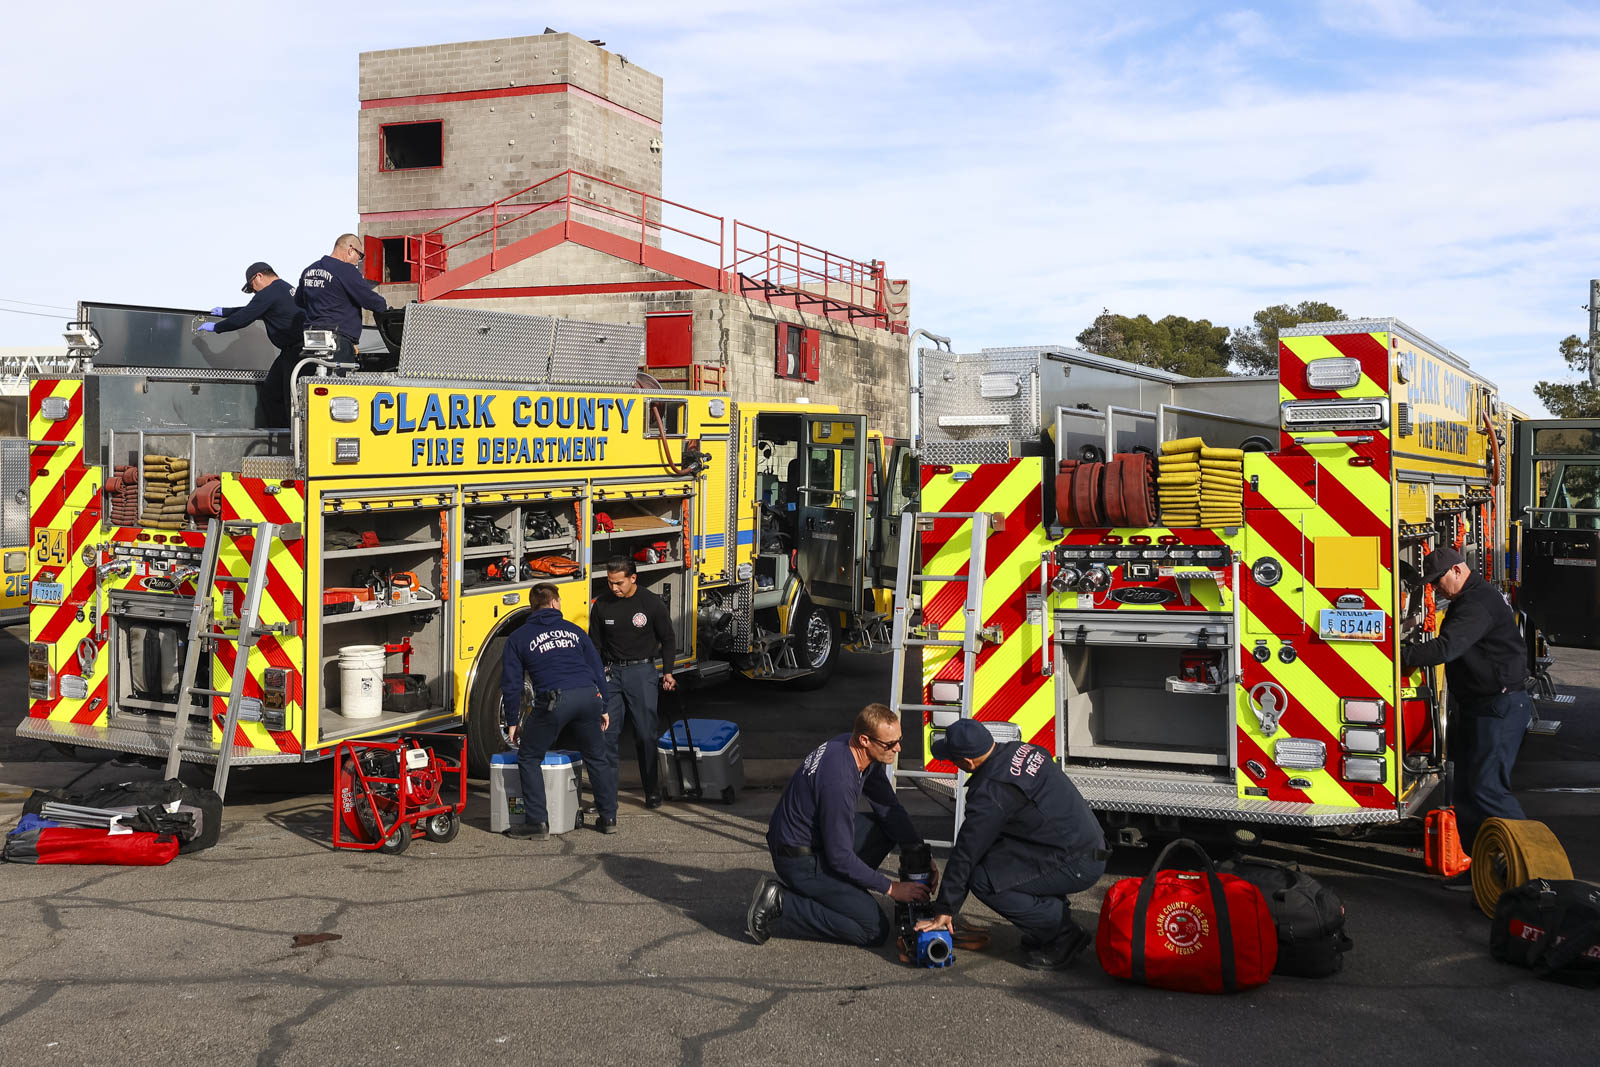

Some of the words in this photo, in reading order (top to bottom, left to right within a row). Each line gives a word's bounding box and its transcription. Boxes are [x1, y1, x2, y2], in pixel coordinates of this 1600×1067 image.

[1408, 350, 1440, 408] CLARK
[370, 392, 496, 436] CLARK
[512, 396, 636, 434] COUNTY
[1418, 412, 1433, 450] FIRE
[1434, 416, 1469, 457] DEPARTMENT
[411, 438, 465, 467] FIRE
[477, 437, 607, 465] DEPARTMENT
[37, 529, 65, 564] 34
[5, 574, 29, 597] 215
[1121, 588, 1162, 601] Pierce
[1339, 619, 1381, 635] 85448
[529, 632, 549, 652] CLARK
[549, 630, 579, 643] COUNTY
[539, 641, 555, 653] FIRE
[1157, 913, 1166, 936] CLARK
[1163, 901, 1188, 914] COUNTY
[1189, 904, 1205, 919] FIRE
[1201, 919, 1209, 936] DEPT
[1164, 940, 1175, 952] LAS
